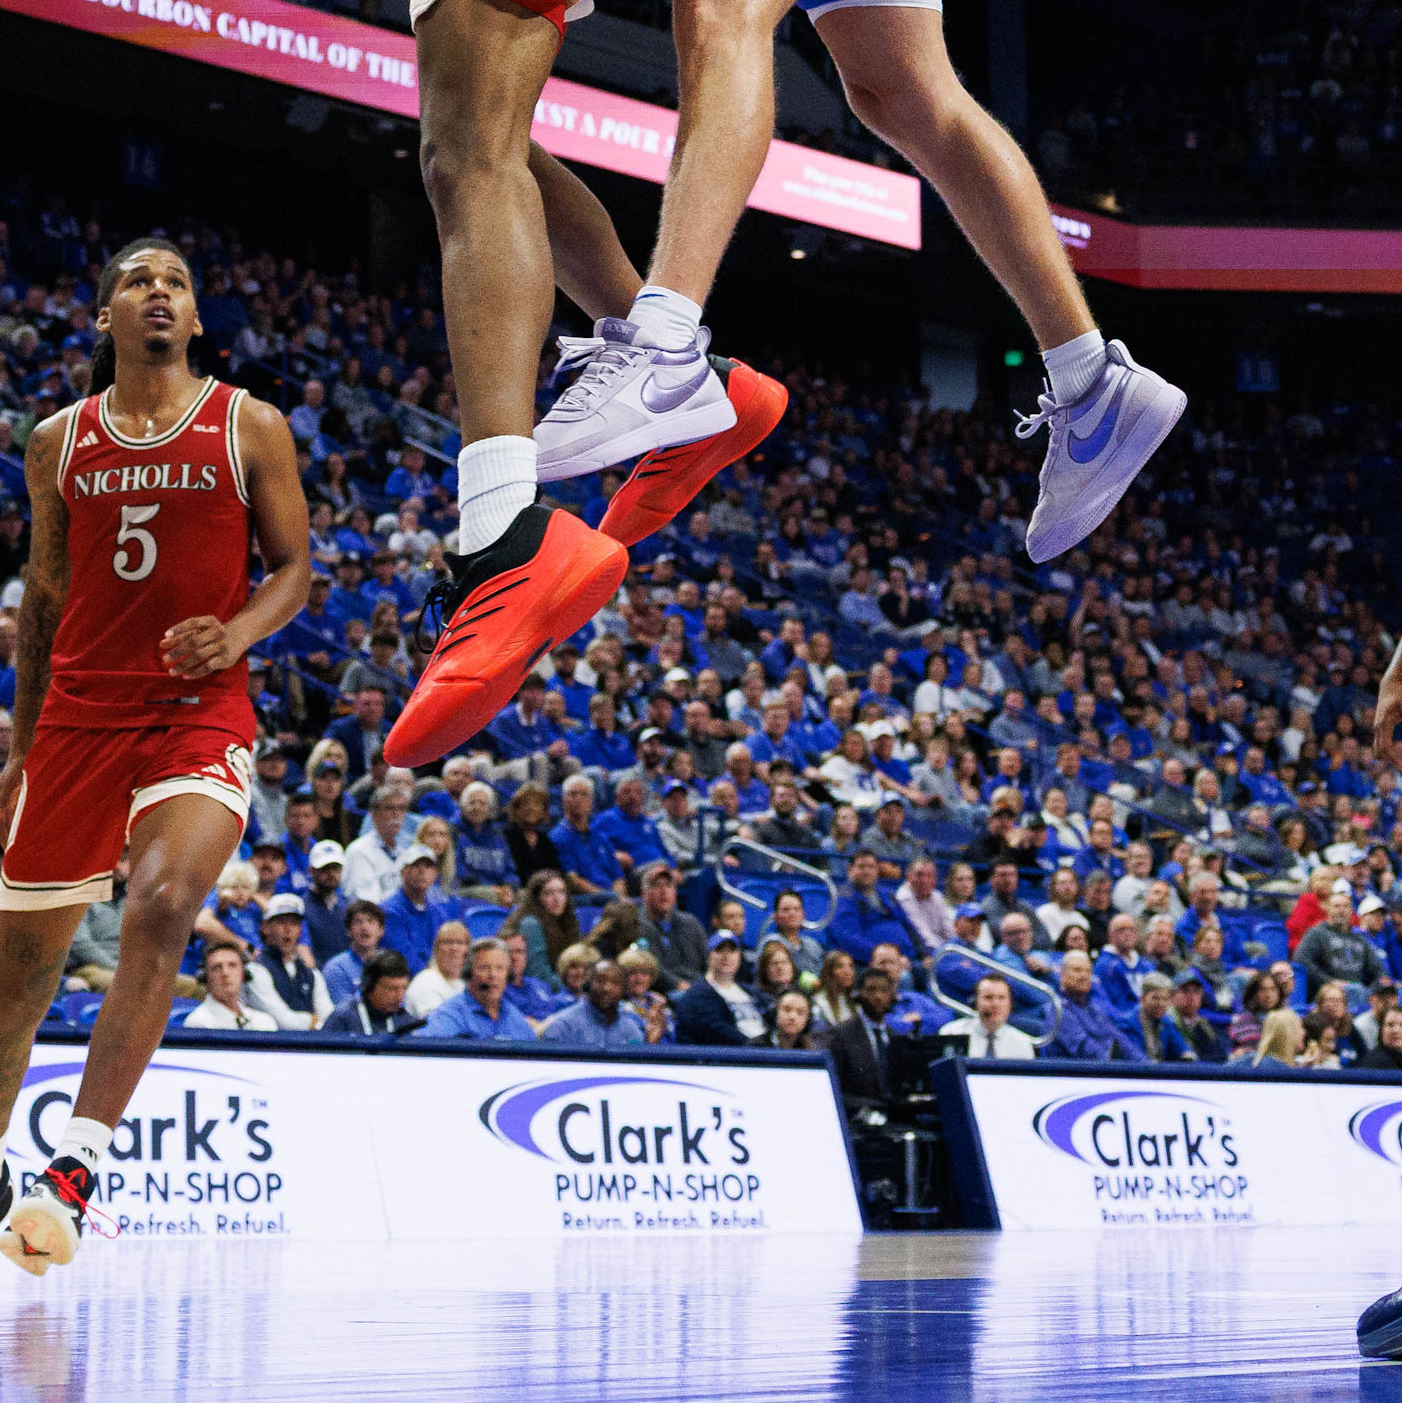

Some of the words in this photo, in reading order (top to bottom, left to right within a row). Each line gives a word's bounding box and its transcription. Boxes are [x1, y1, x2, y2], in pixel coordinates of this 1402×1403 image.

[216, 12, 325, 65] CAPITAL
[328, 41, 365, 72] OF
[366, 53, 416, 88] THE
[73, 463, 218, 499] NICHOLLS
[112, 502, 161, 582] 5
[29, 1089, 274, 1163] Cark's
[557, 1099, 751, 1165] Clark's
[1091, 1110, 1239, 1168] Clark's
[19, 1172, 283, 1204] PP-N-SHOP
[555, 1172, 761, 1203] PUMP-N-SHOP
[1094, 1174, 1249, 1200] PUMP-N-SHOP
[217, 1214, 292, 1236] Refuel.
